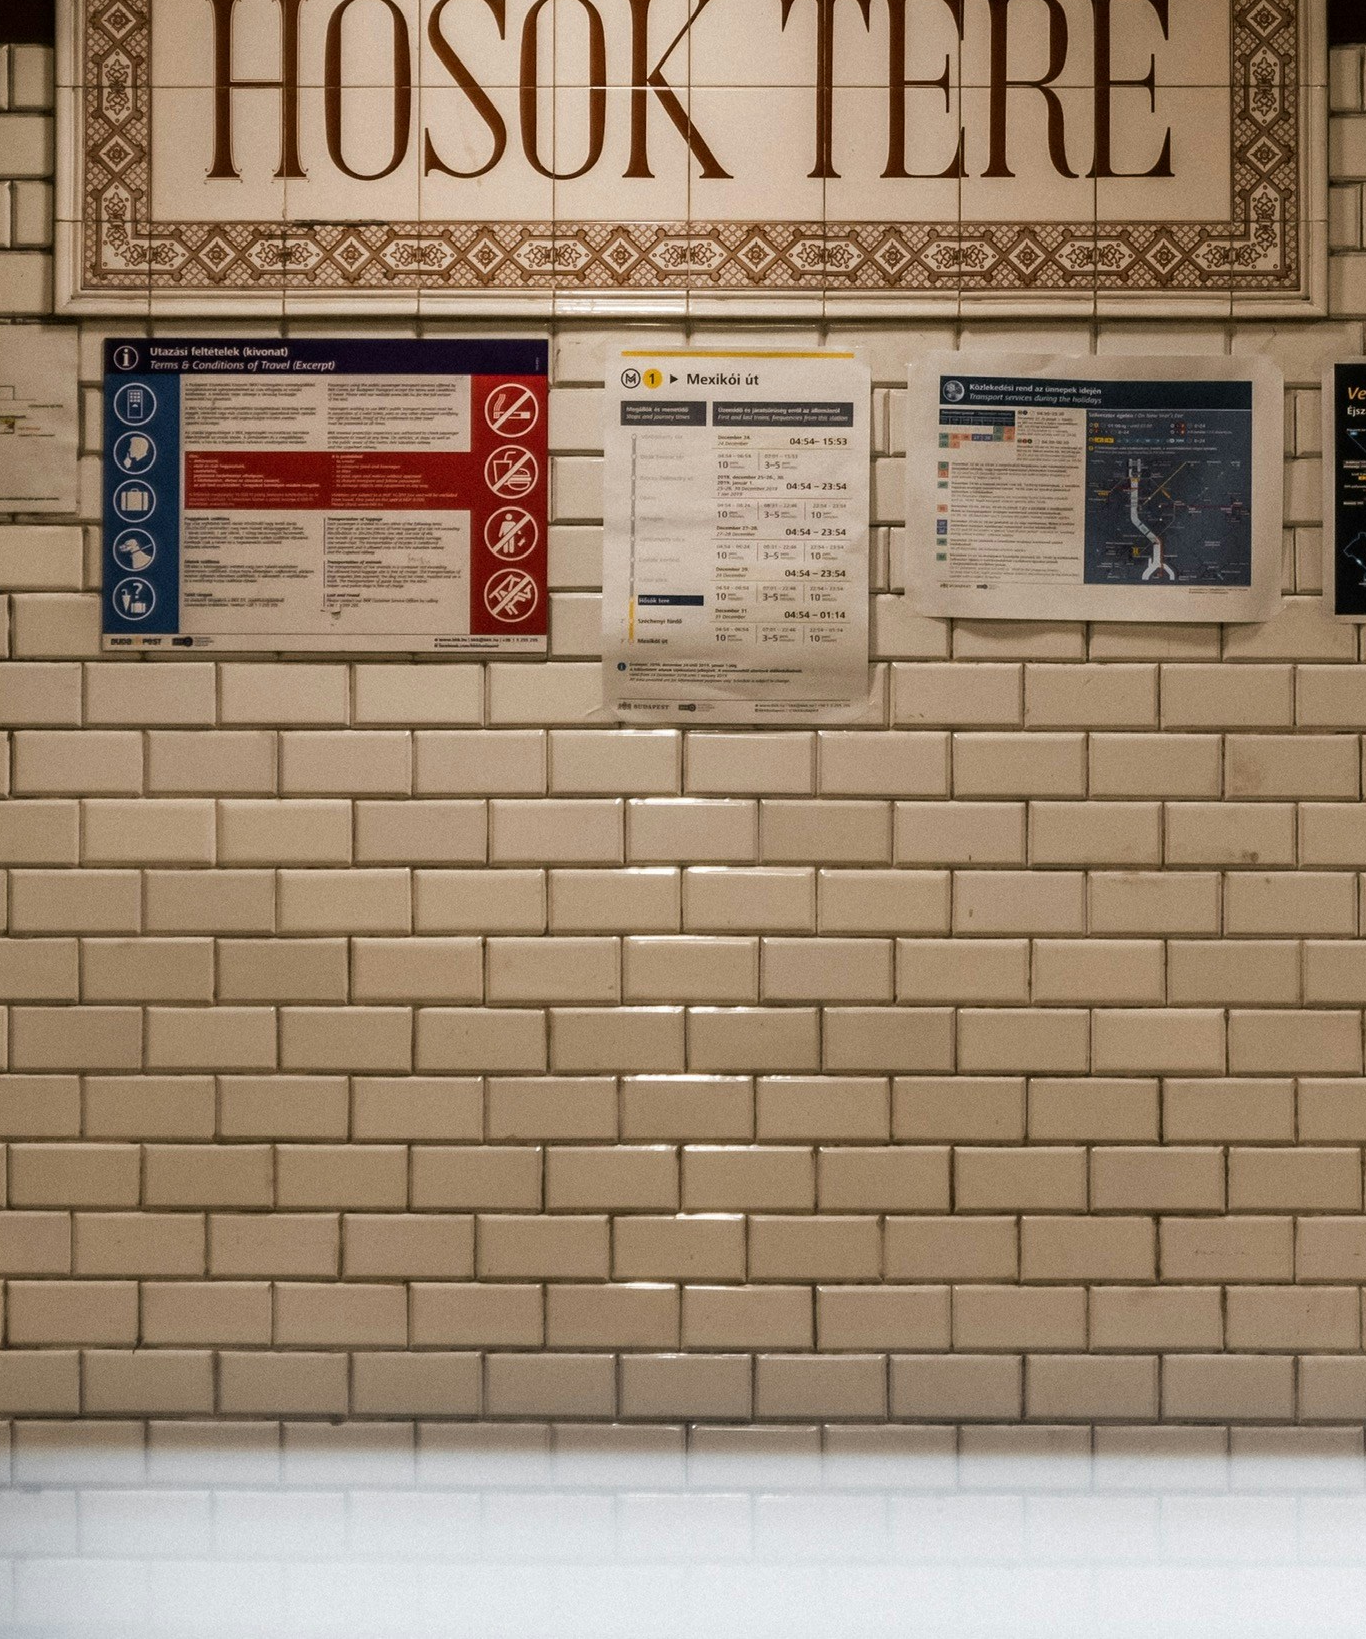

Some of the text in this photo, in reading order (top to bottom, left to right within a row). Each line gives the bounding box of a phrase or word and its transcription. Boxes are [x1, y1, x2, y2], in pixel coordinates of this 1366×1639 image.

[150, 347, 289, 358] Utazási feltételek (kivonat)
[151, 361, 336, 372] Terms & Conditions of Travel (Excerpt)
[649, 373, 655, 384] 1
[687, 373, 741, 385] Mexikói
[745, 373, 759, 385] út
[970, 383, 1014, 392] Közlekedési
[1045, 386, 1077, 395] ünnepek
[1079, 387, 1102, 396] idején
[970, 393, 1004, 402] Transport
[1034, 395, 1057, 404] during
[1059, 395, 1071, 403] the
[1072, 396, 1102, 405] holidays
[823, 437, 848, 446] 15:53
[718, 461, 729, 469] 10
[786, 483, 811, 491] 04:54
[822, 483, 847, 491] 23:54
[811, 511, 822, 519] 10
[716, 593, 727, 601] 10
[784, 611, 810, 619] 04:54
[820, 611, 846, 619] 01:14
